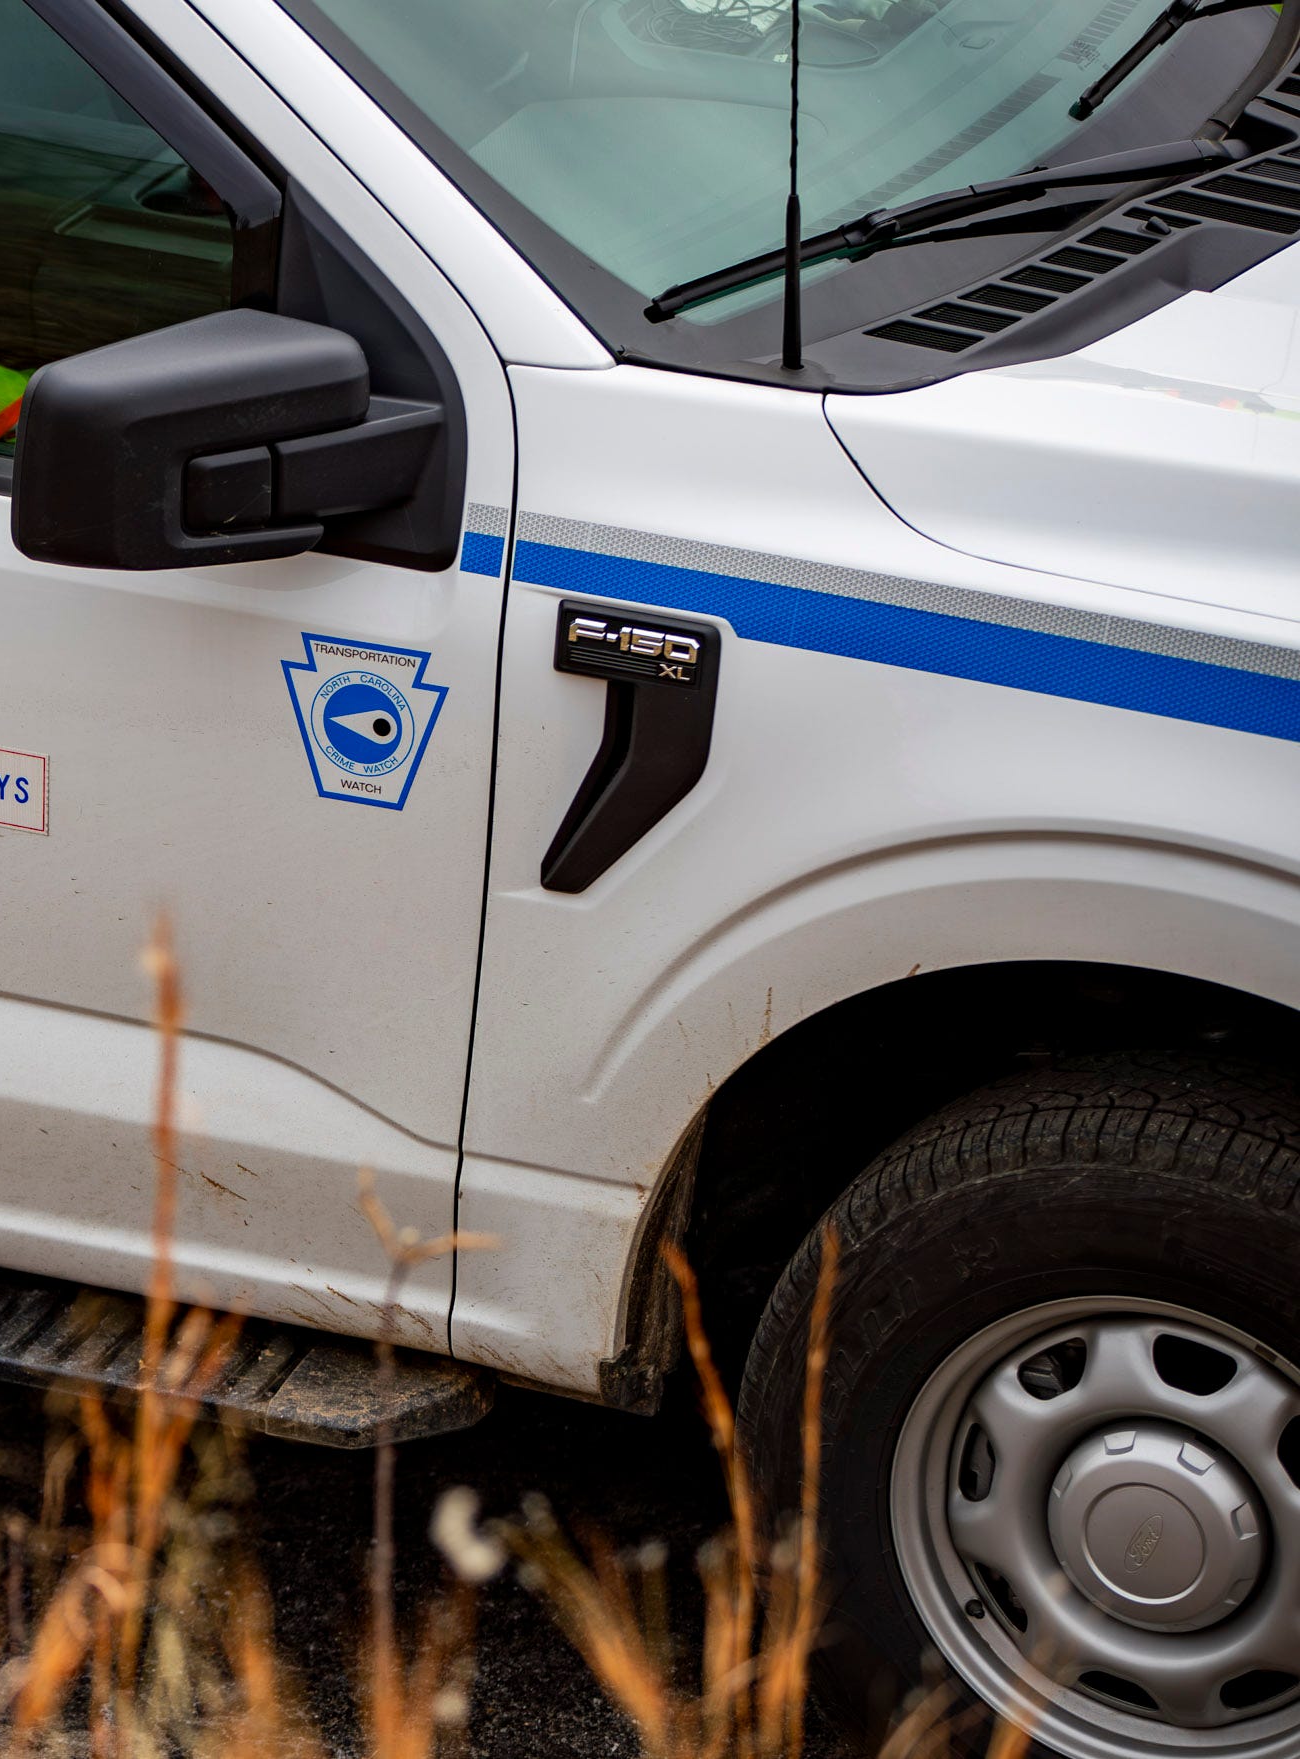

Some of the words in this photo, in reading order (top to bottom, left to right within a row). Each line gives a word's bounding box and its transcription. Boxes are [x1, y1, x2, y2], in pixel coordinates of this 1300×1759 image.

[568, 617, 700, 664] F-150
[314, 643, 416, 668] TRANSPORTATION
[658, 663, 691, 681] XL
[320, 675, 351, 700] NORTH
[359, 674, 406, 712] CAROLINA
[325, 745, 356, 771] CRIME
[363, 756, 399, 774] WATCH
[340, 779, 382, 795] WATCH
